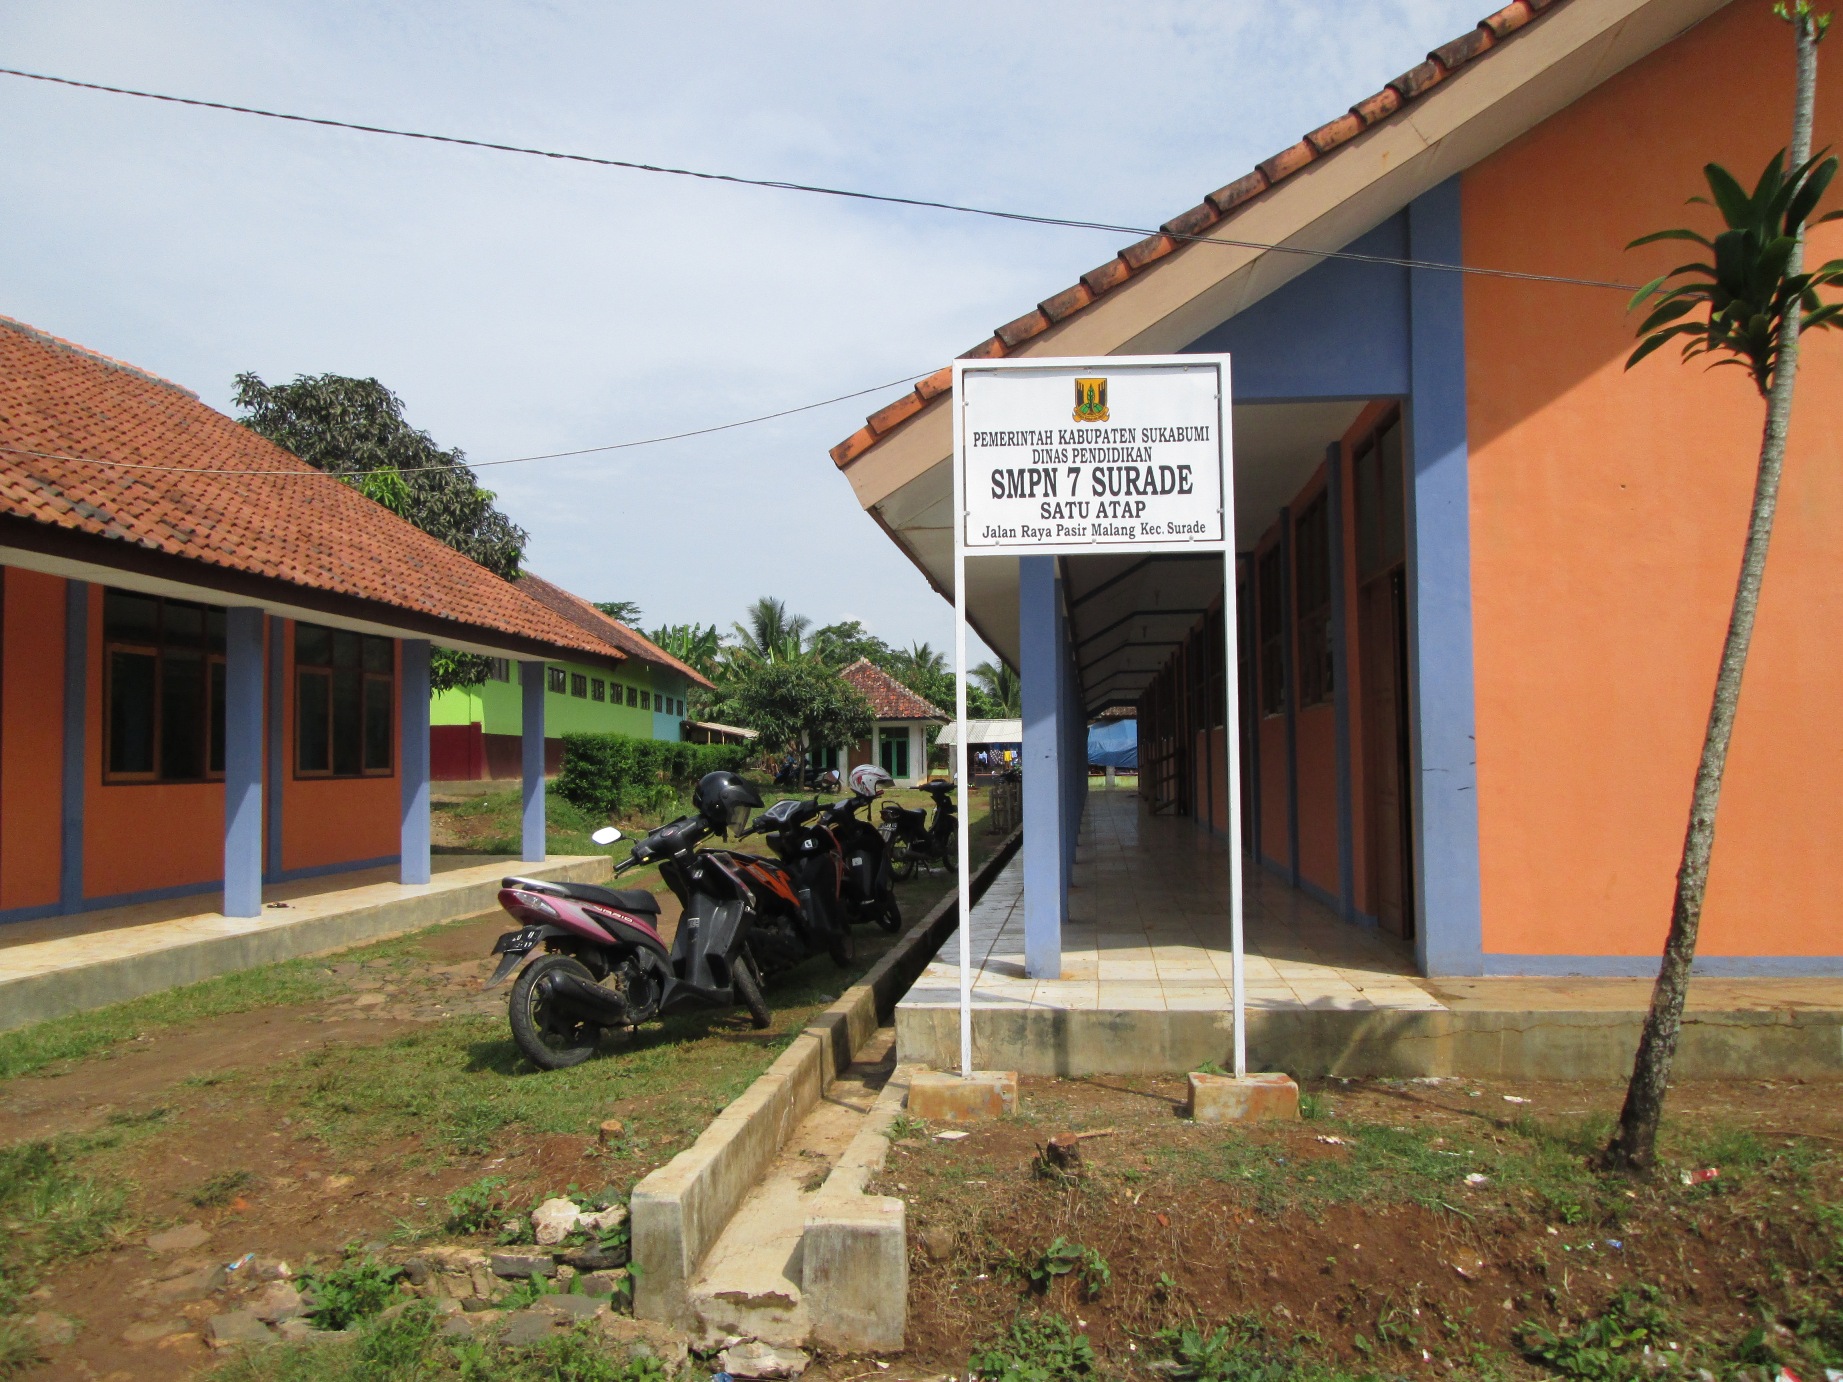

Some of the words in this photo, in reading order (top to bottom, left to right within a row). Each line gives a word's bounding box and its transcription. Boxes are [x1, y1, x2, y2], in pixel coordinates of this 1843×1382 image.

[973, 430, 1054, 447] PEMERINTAH
[1058, 427, 1137, 445] KABUPATEN
[1141, 425, 1210, 443] SUKABUMI
[1032, 448, 1069, 464] DINAS
[1071, 446, 1152, 463] PENDIDIKAN
[991, 467, 1058, 500] SMPN
[1066, 466, 1081, 497] 7
[1091, 464, 1194, 498] SURADE
[1040, 501, 1090, 520] SATU
[1095, 500, 1147, 519] ATAP
[982, 525, 1017, 539] Jalan
[1021, 524, 1052, 542] Raya
[1056, 523, 1087, 537] Pasir
[1091, 522, 1136, 540] Malang
[1140, 521, 1165, 535] Kec.
[1167, 520, 1206, 535] Surade
